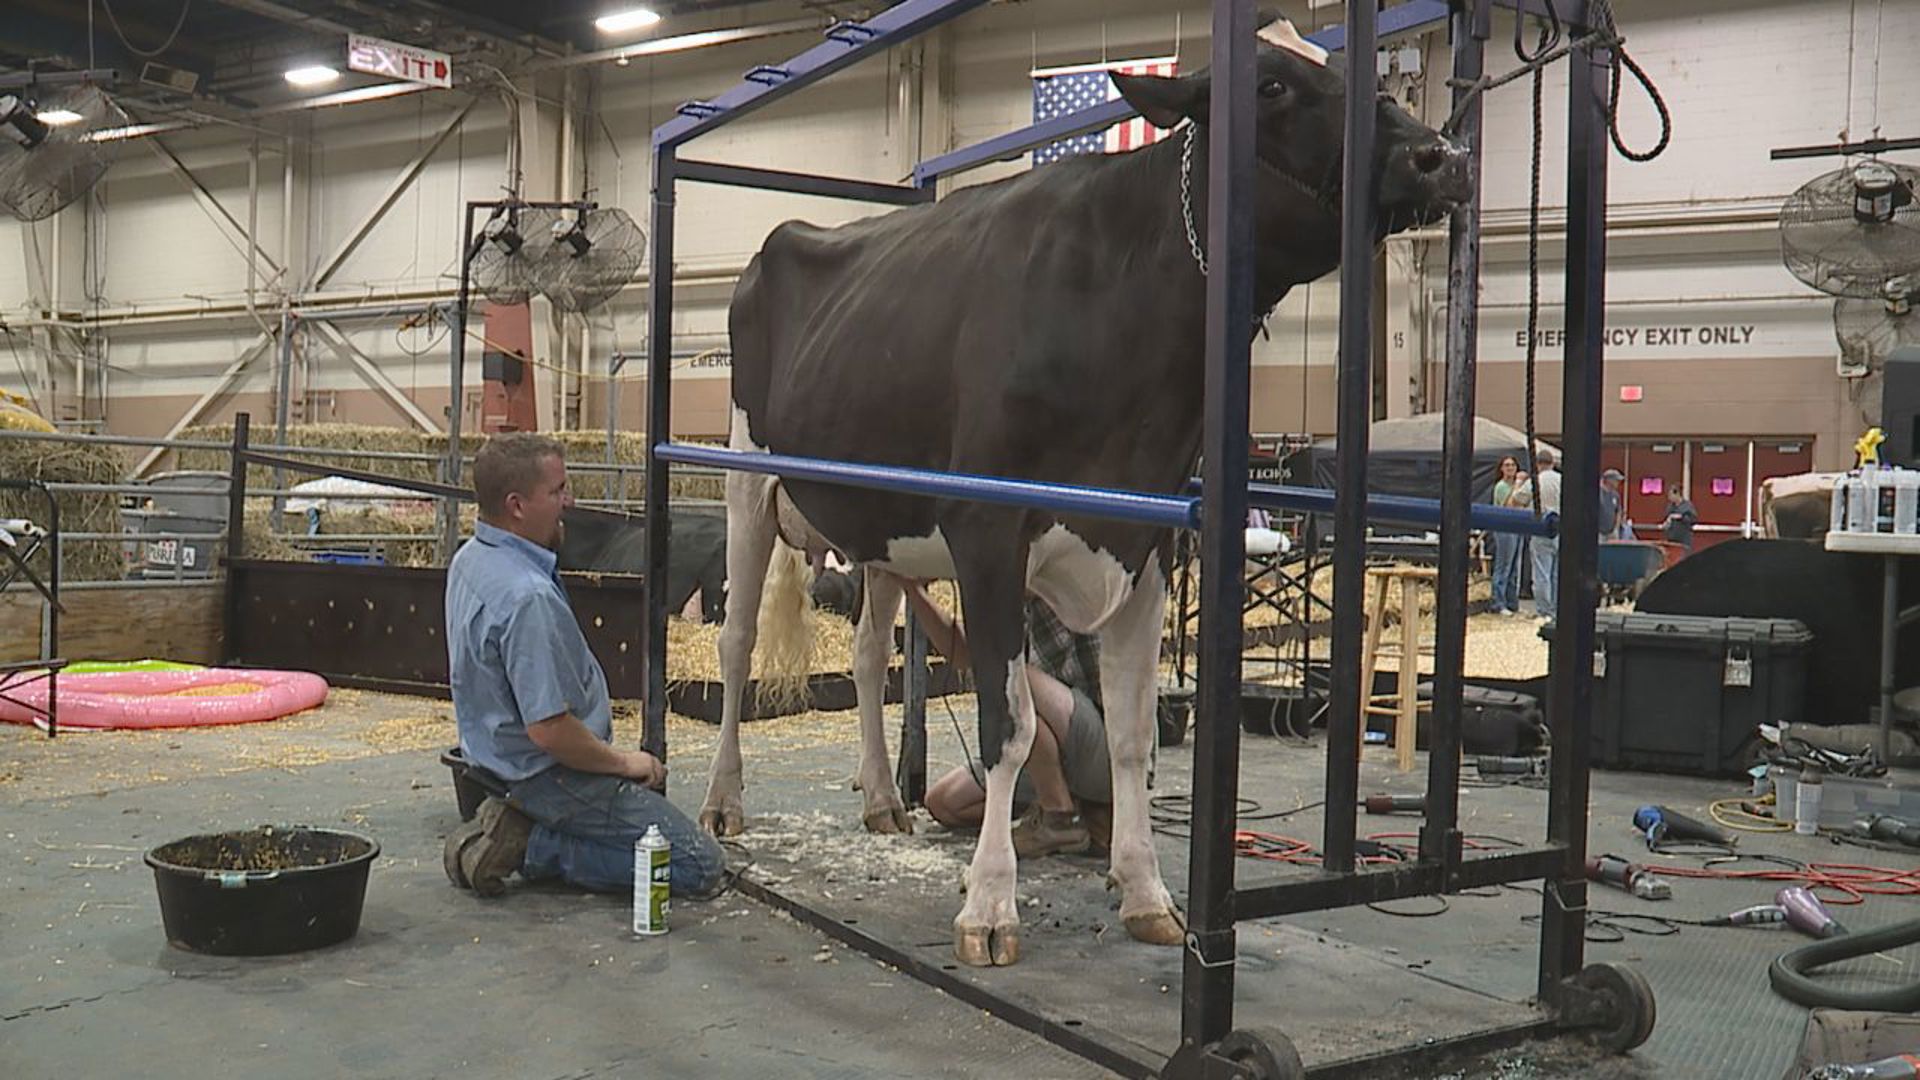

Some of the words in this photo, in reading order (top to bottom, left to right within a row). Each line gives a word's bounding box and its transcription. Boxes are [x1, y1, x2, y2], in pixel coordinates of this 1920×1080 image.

[350, 46, 432, 80] EXIT
[1393, 331, 1404, 348] 15
[1645, 328, 1692, 345] EXIT
[1698, 326, 1754, 344] ONLY
[145, 545, 193, 564] PURIA
